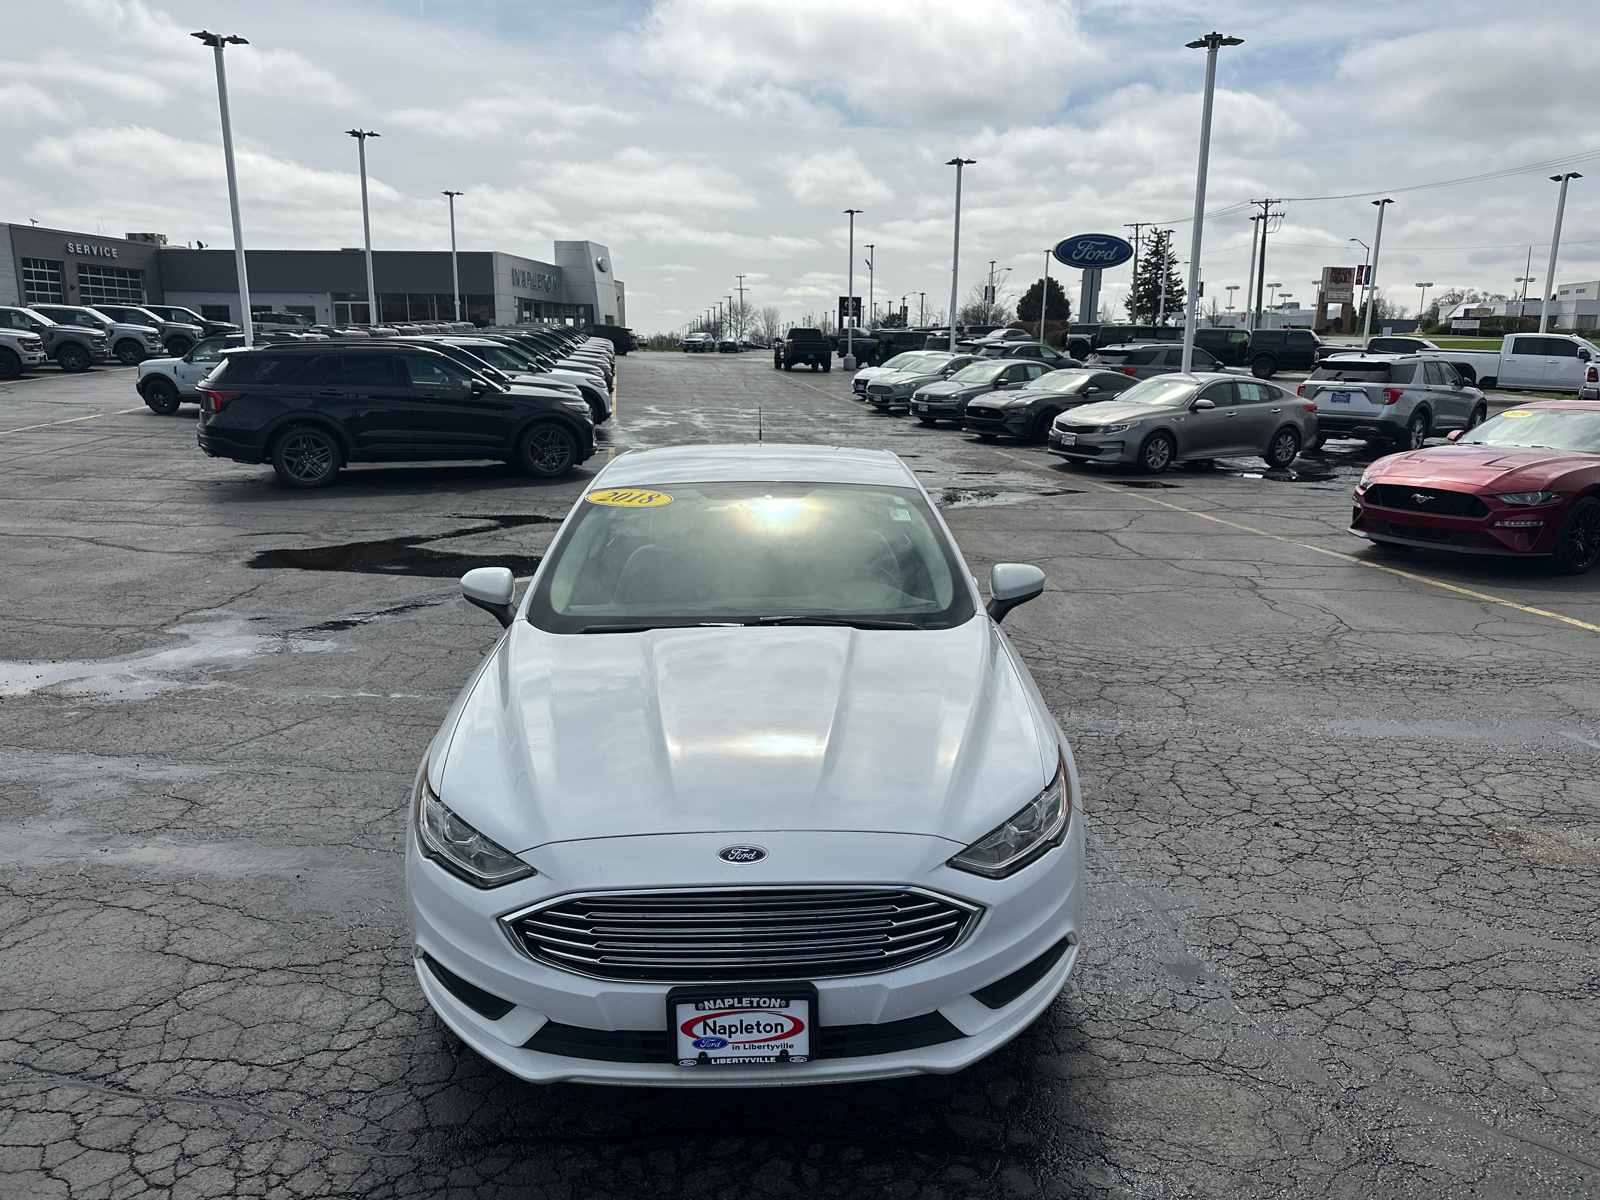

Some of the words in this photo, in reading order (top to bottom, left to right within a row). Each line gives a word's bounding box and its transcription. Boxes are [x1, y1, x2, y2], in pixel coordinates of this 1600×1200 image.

[67, 242, 118, 258] SERVICE
[1071, 240, 1119, 261] Ford
[511, 267, 558, 293] NAPLETON
[595, 491, 661, 504] 2018
[727, 848, 757, 860] Ford
[703, 997, 781, 1010] NAPLETON
[702, 1019, 785, 1038] Napleton
[699, 1039, 722, 1048] Ford
[743, 1043, 795, 1051] Libertyville
[711, 1056, 777, 1065] LIBERTYVILLE
